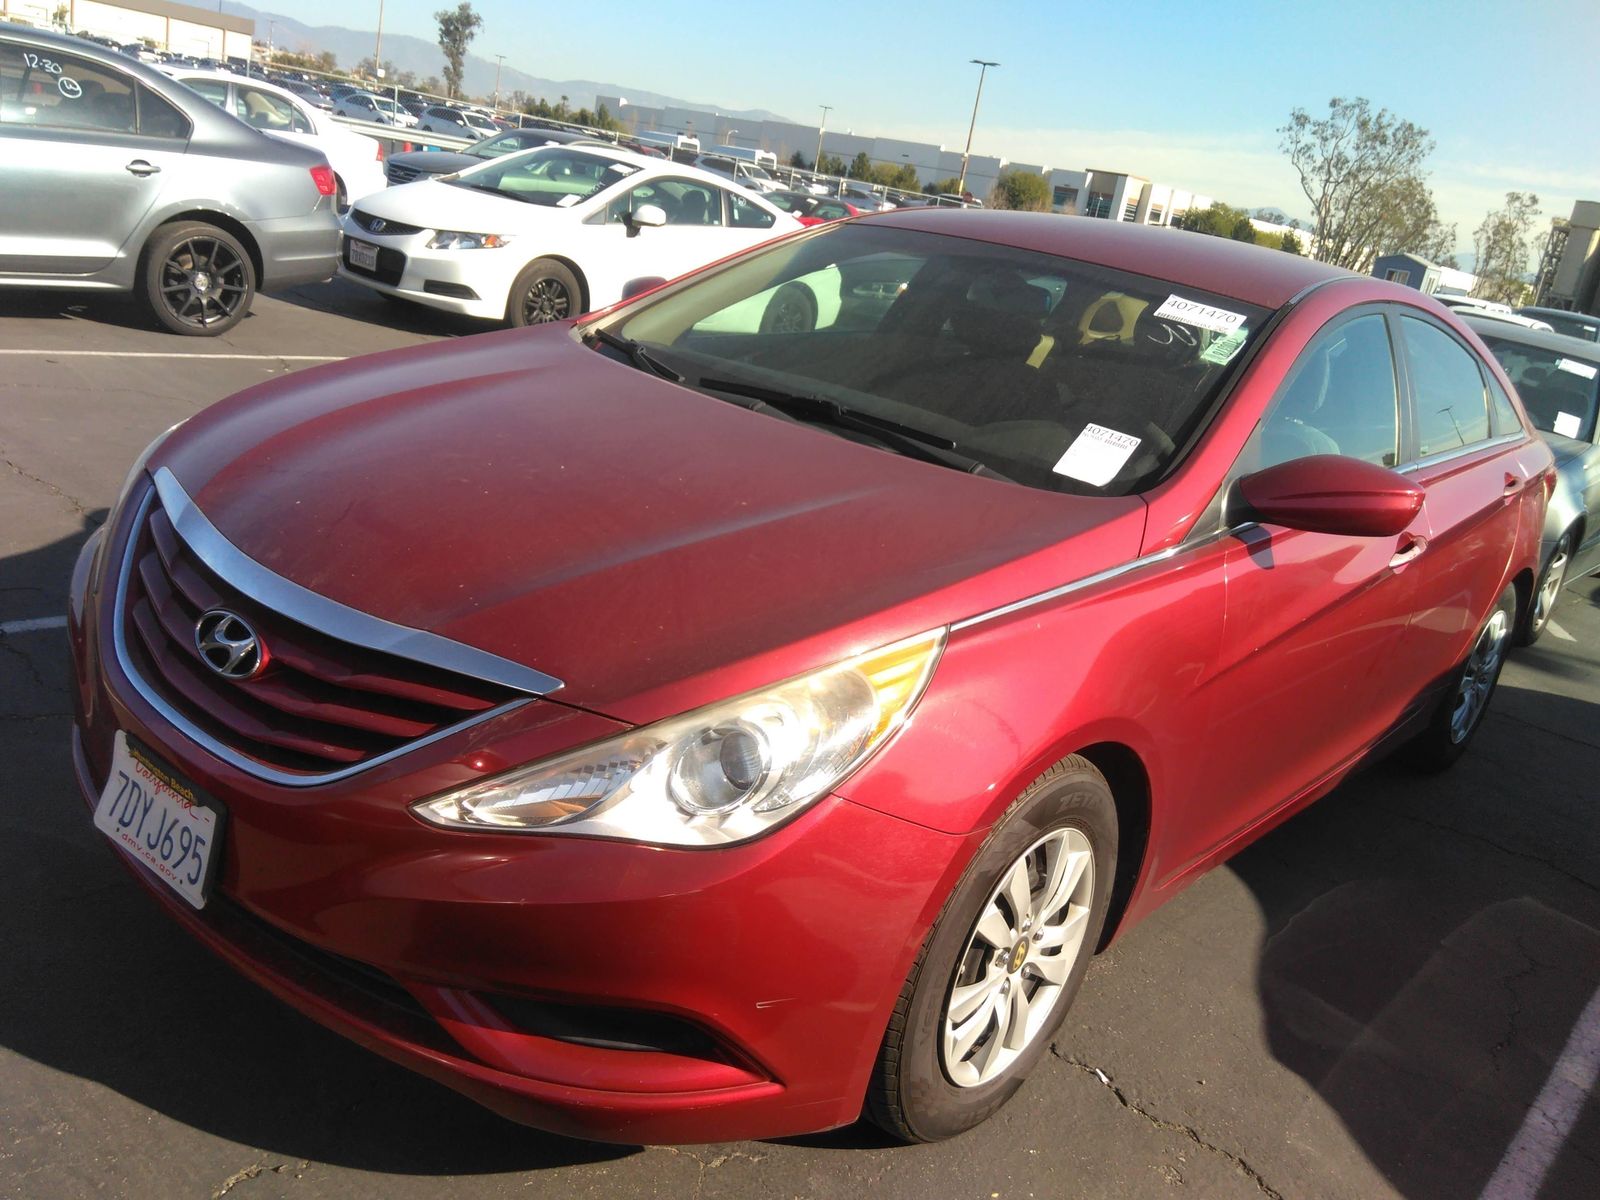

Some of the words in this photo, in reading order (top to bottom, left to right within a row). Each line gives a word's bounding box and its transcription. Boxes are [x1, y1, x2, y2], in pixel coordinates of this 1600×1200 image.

[1166, 299, 1238, 324] 4071470
[1084, 425, 1140, 448] 4071470
[109, 769, 206, 886] 7DYJ695
[121, 832, 177, 881] dmv.ca.gov
